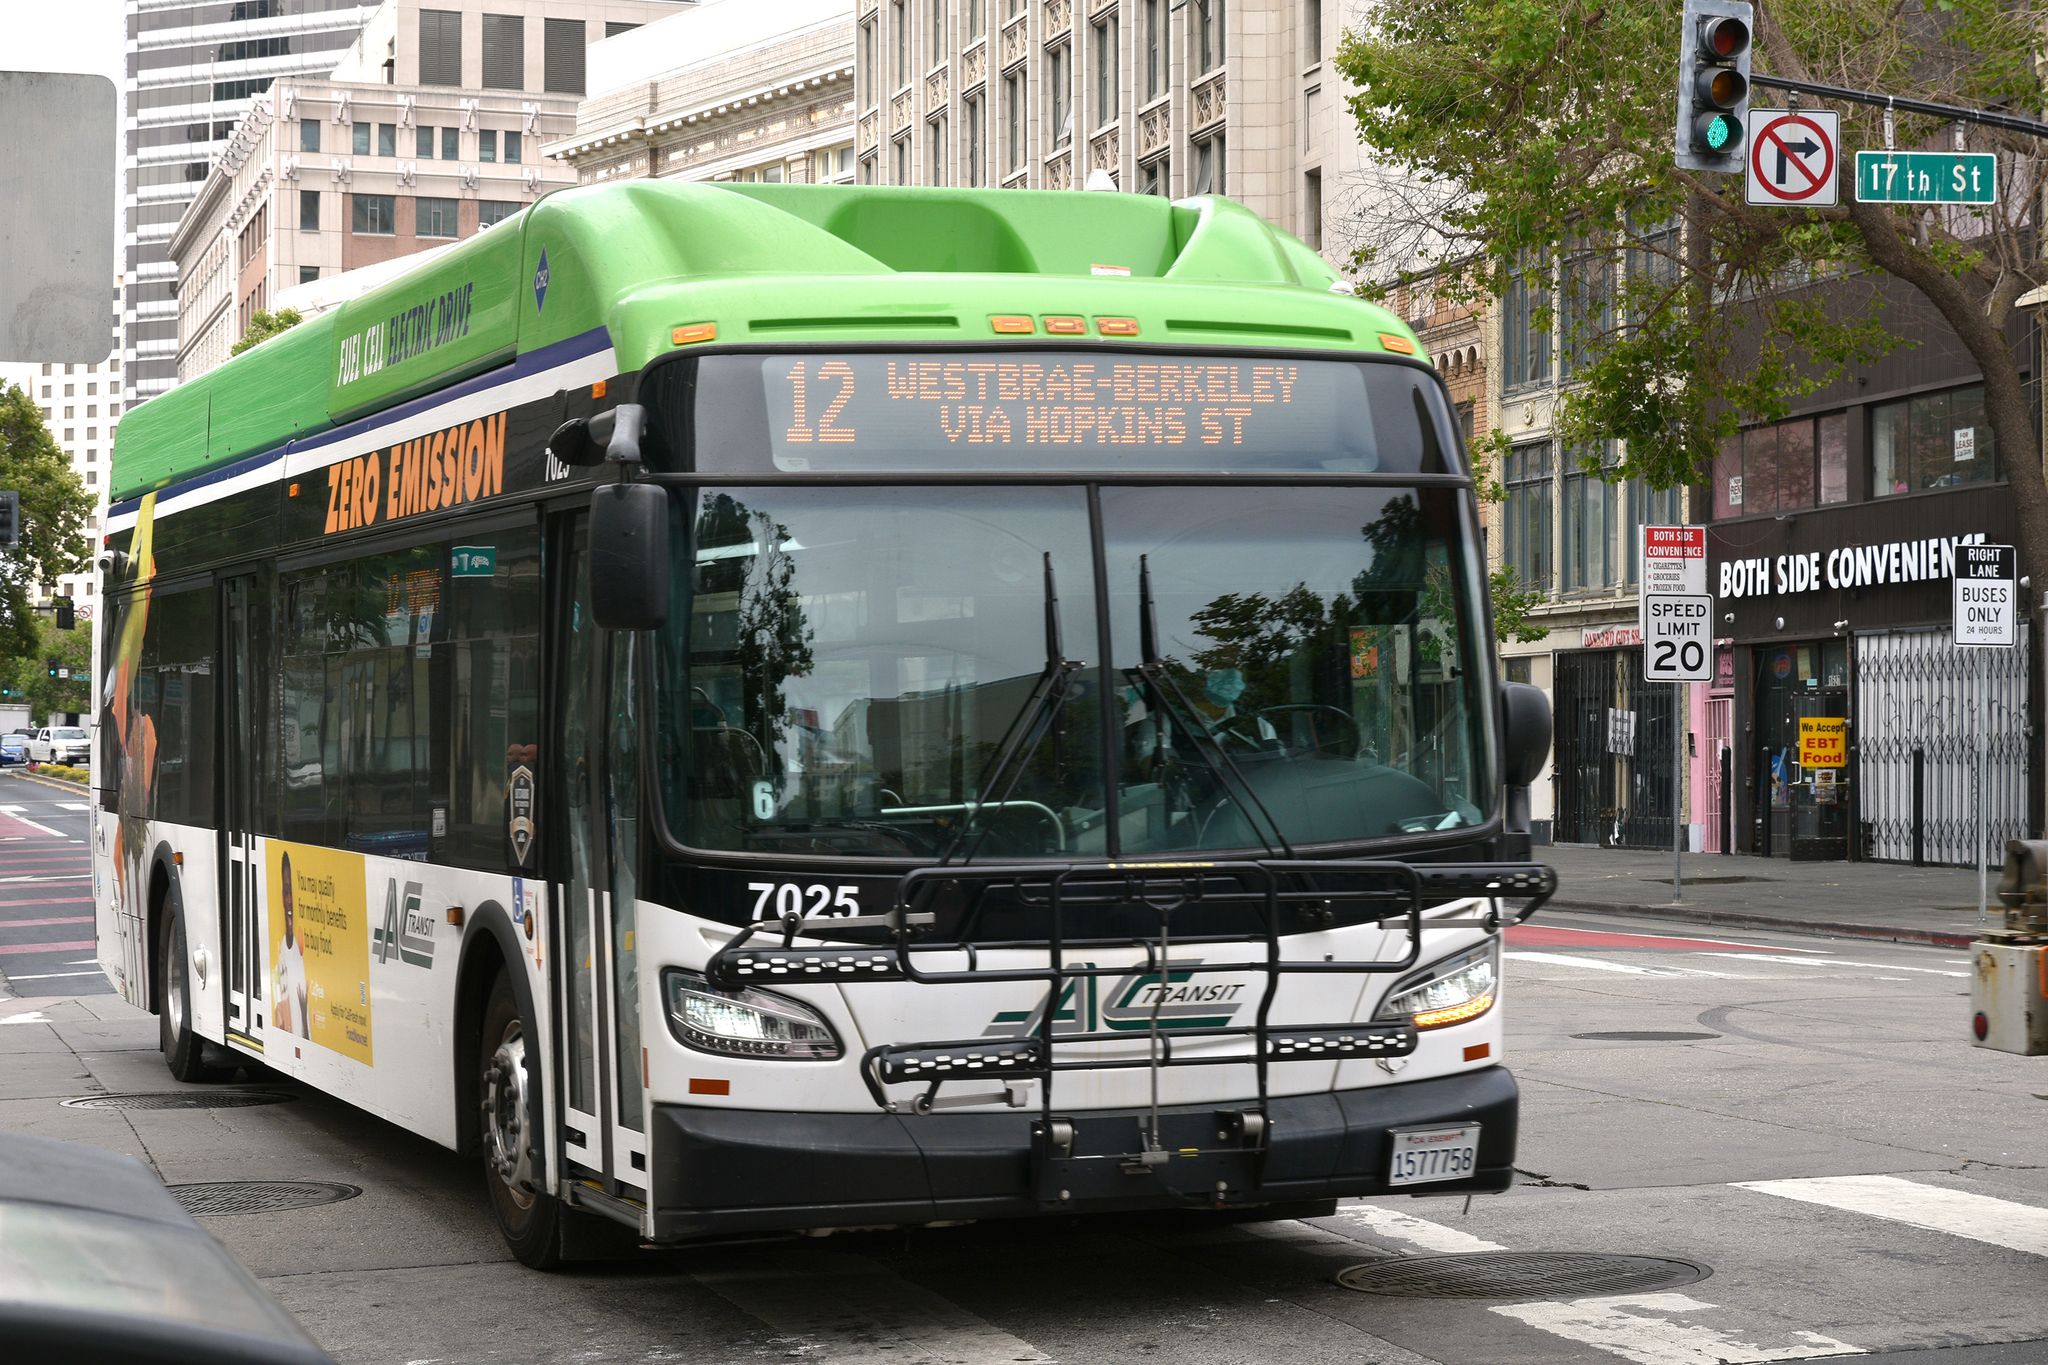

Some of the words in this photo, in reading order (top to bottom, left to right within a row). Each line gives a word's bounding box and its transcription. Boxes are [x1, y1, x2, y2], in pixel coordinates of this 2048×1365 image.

[1952, 164, 1981, 192] St
[336, 332, 361, 388] FUEL
[363, 321, 385, 377] CELL
[386, 297, 435, 367] ELECTRIC
[435, 281, 473, 347] DRIVE
[887, 362, 1297, 403] WESTBRAE-BERKELEY
[786, 361, 855, 442] 12
[940, 404, 1011, 443] VIA
[1026, 405, 1186, 445] HOPKINS
[1200, 407, 1252, 445] ST
[324, 451, 381, 535] ZERO
[386, 411, 508, 521] EMISSION
[1653, 531, 1674, 541] BOTH
[1676, 531, 1694, 542] SIDE
[1647, 545, 1702, 557] CONVENIENCE
[1968, 548, 2001, 562] RIGHT
[1653, 562, 1682, 570] CIGARETTES
[1719, 557, 1770, 599] BOTH
[1776, 552, 1820, 595] SIDE
[1827, 533, 1986, 590] CONVENIEN
[1969, 564, 2000, 578] LANE
[1673, 584, 1686, 592] FOOD
[1962, 587, 2007, 603] BUSES
[1652, 603, 1707, 618] SPEED
[1968, 607, 2001, 623] ONLY
[1657, 622, 1700, 636] LIMIT
[1966, 625, 1975, 635] 24
[1978, 626, 2003, 635] HOURS
[1653, 640, 1704, 672] 20
[1802, 723, 1814, 733] We
[1816, 722, 1844, 735] Accept
[1806, 737, 1839, 749] EBT
[1803, 752, 1843, 763] Food
[753, 781, 774, 820] 6
[748, 882, 860, 921] 7025
[372, 877, 435, 970] AC
[407, 914, 435, 937] TRANSIT
[981, 959, 1242, 1036] AC
[1141, 984, 1244, 1004] TRANSIT
[1394, 1147, 1473, 1178] 1577758
